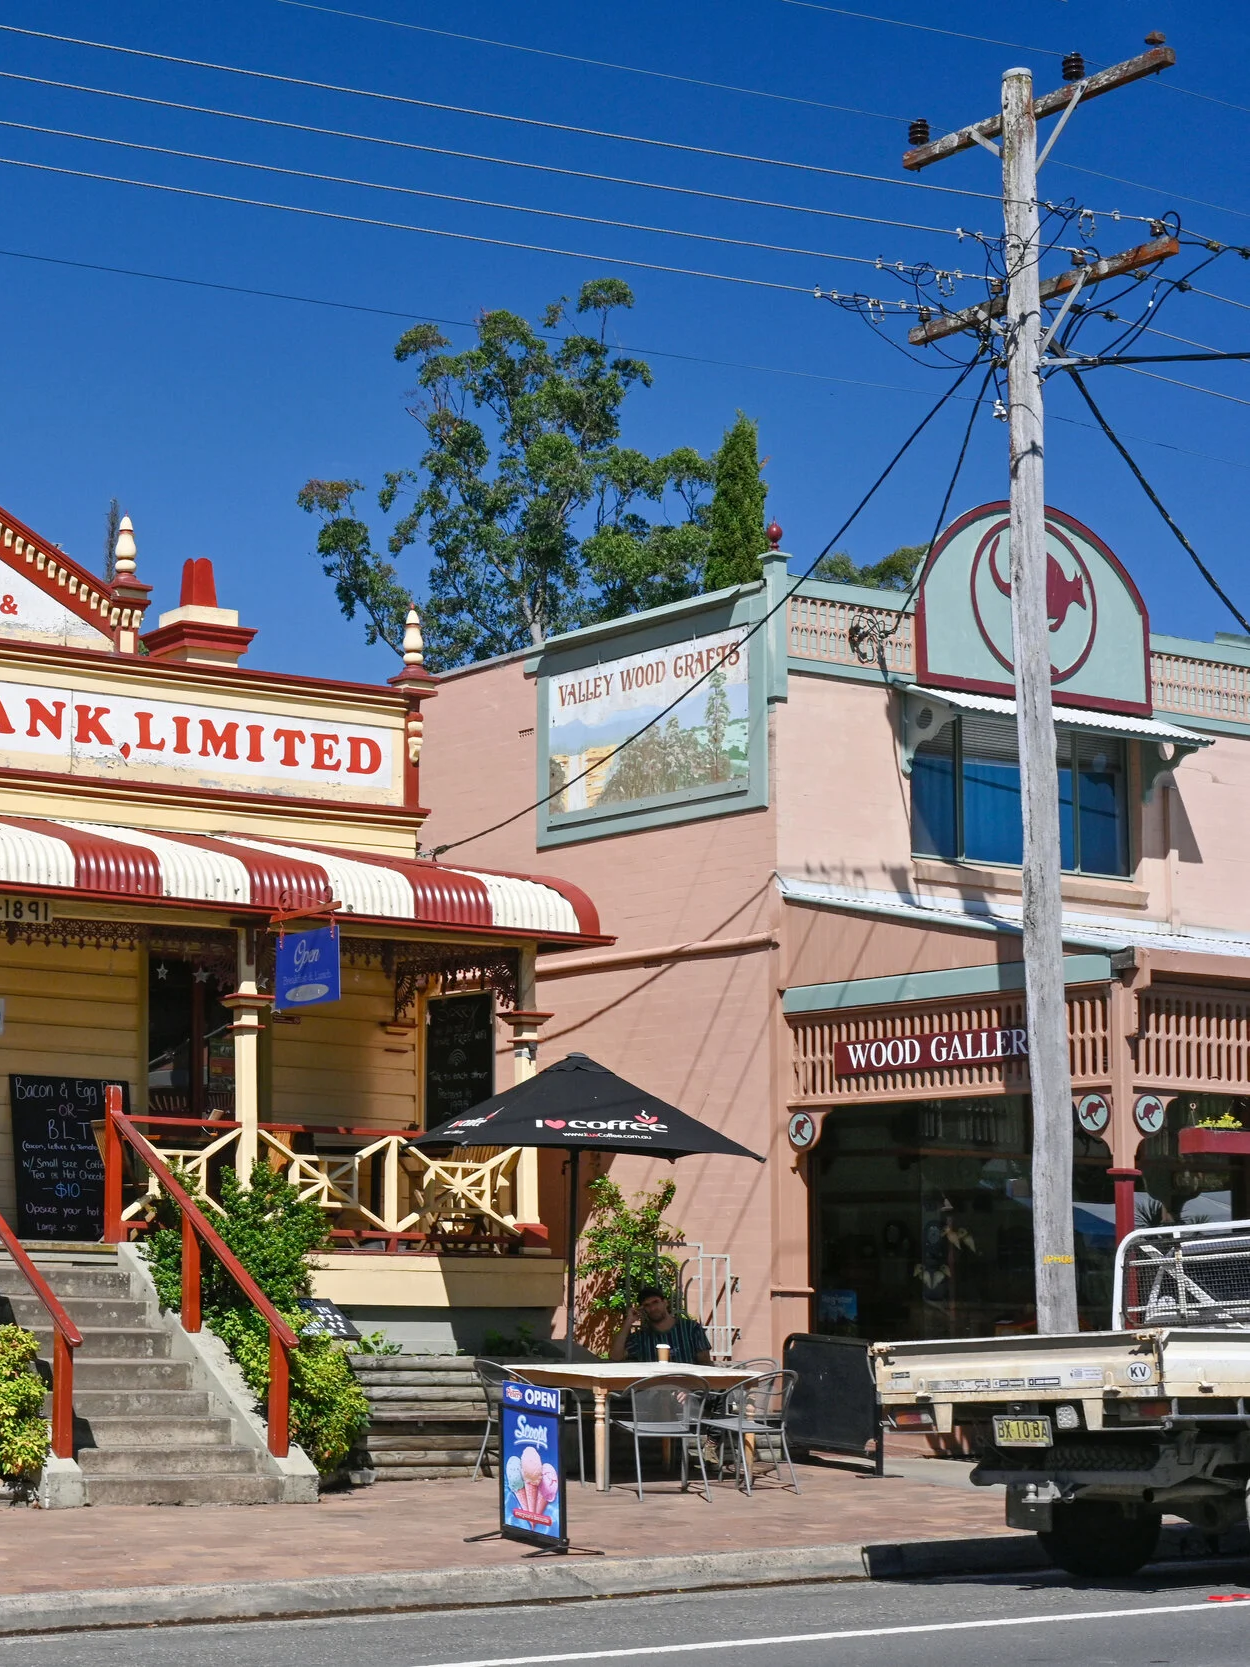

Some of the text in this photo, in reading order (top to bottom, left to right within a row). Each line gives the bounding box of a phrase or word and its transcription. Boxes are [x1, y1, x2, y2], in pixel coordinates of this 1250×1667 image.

[0, 594, 18, 615] &
[558, 673, 614, 706] VALLEY
[620, 660, 666, 692] WOOD
[294, 940, 321, 973] Open
[847, 1028, 1029, 1069] WOOD GALLER
[15, 1077, 54, 1100] Bacon
[59, 1082, 68, 1099] &
[76, 1081, 98, 1105] Egg
[59, 1102, 77, 1118] OR
[535, 1119, 543, 1128] I
[37, 1158, 58, 1169] Small
[62, 1160, 78, 1168] size
[31, 1170, 45, 1179] Tea
[63, 1169, 76, 1179] Hot
[54, 1181, 81, 1198] $10
[25, 1202, 99, 1218] Upsize your hot
[36, 1222, 57, 1234] Large
[1130, 1366, 1147, 1378] KV
[524, 1389, 556, 1409] OPEN
[514, 1415, 548, 1449] Scoops
